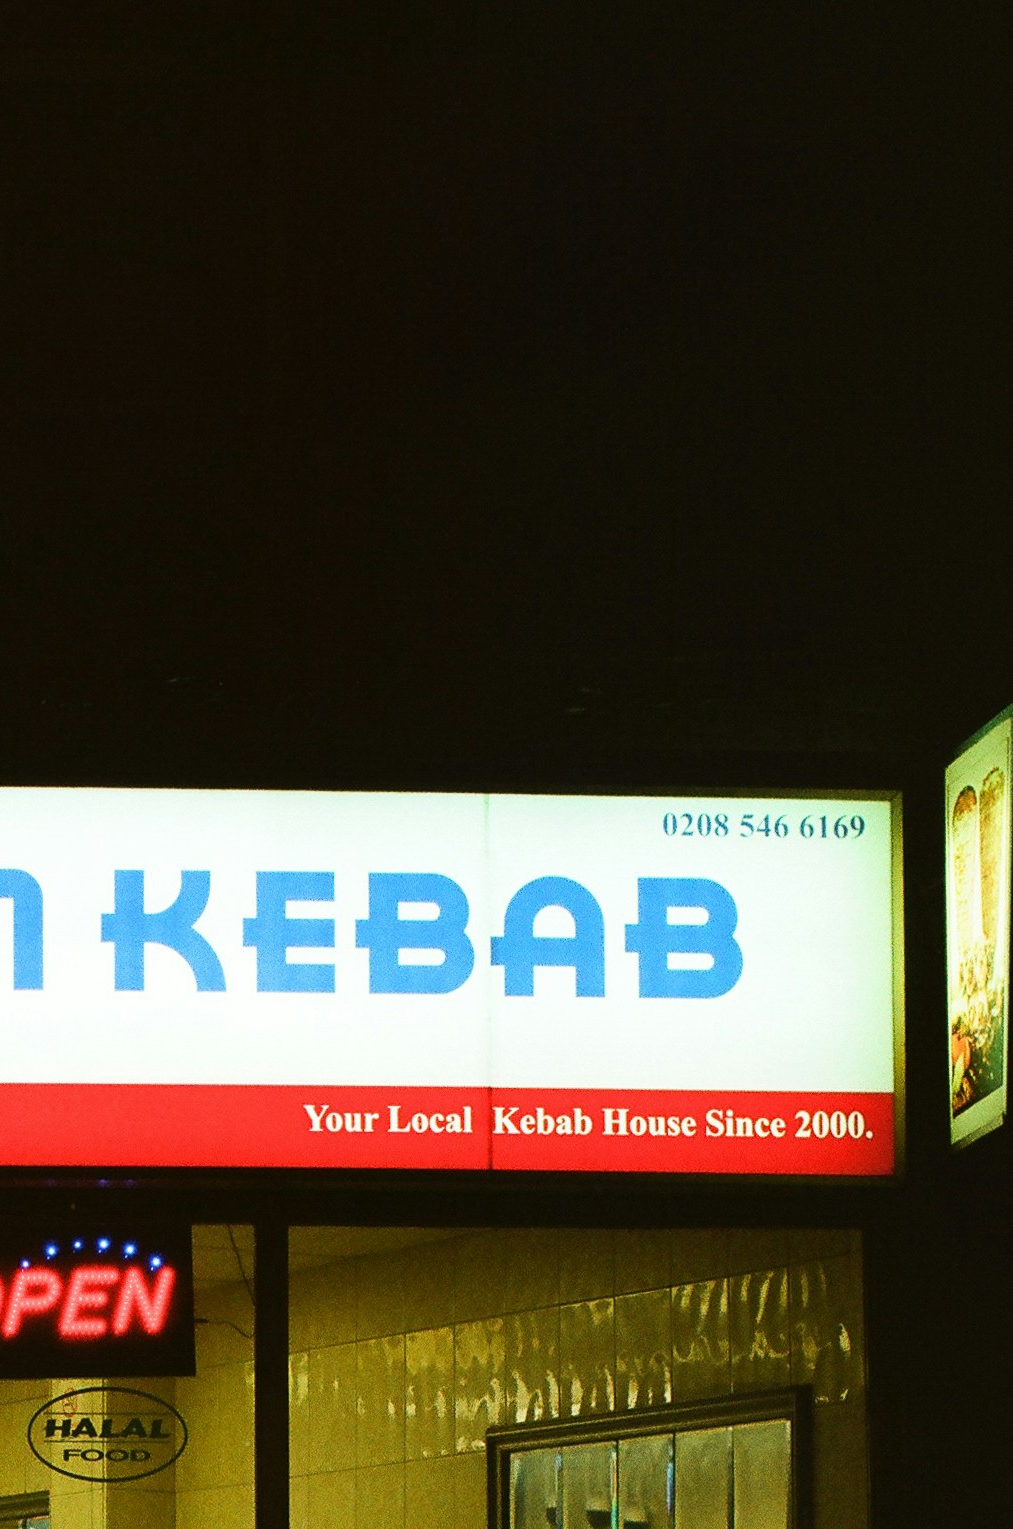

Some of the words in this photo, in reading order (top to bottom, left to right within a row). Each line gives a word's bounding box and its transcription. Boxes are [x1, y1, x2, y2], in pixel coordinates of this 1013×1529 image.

[663, 813, 729, 836] 0208
[740, 814, 789, 837] 546
[799, 815, 866, 839] 6169
[101, 869, 744, 999] KEBAB
[303, 1104, 380, 1133] Your
[387, 1105, 473, 1134] Local
[492, 1106, 593, 1136] Kebab
[602, 1108, 697, 1137] House
[705, 1108, 786, 1138] Since
[794, 1110, 874, 1140] 2000.
[45, 1418, 171, 1438] HALAL
[63, 1449, 151, 1461] FOOD
